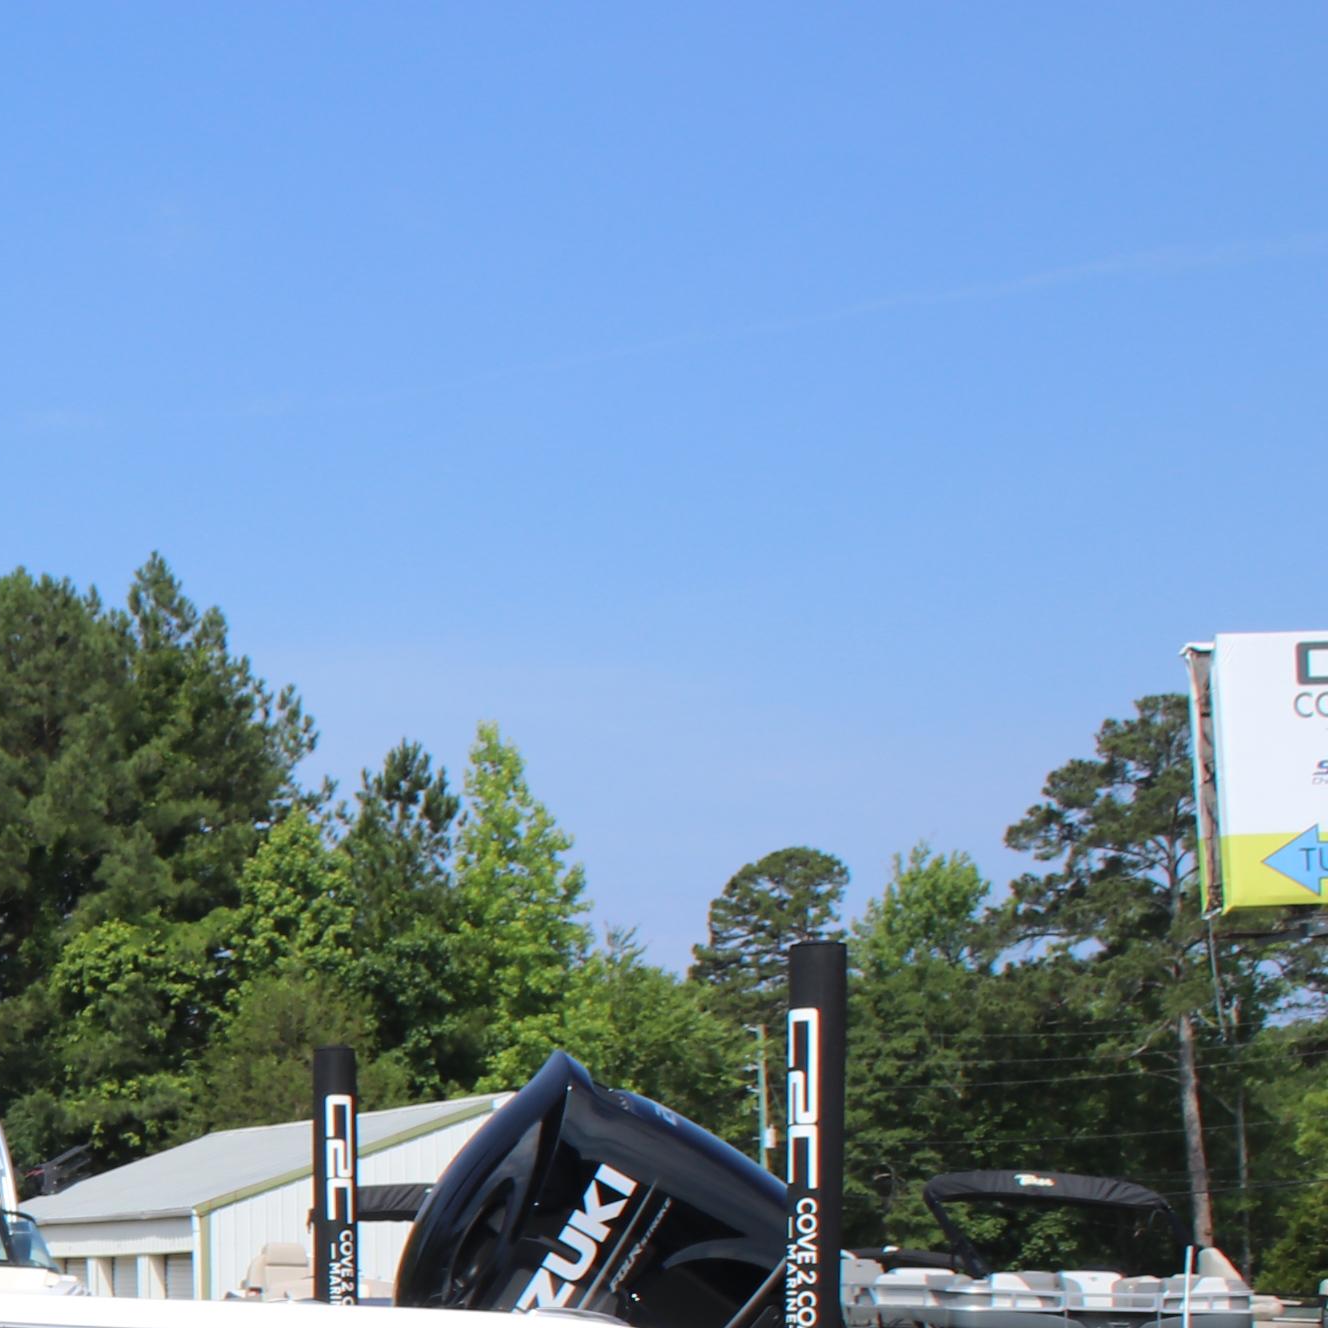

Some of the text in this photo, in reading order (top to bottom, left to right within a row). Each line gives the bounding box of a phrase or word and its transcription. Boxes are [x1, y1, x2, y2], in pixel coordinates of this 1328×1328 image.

[512, 1163, 638, 1312] ZUKI
[796, 1197, 818, 1265] COVE
[786, 1244, 798, 1324] MARINE
[796, 1271, 818, 1285] 2
